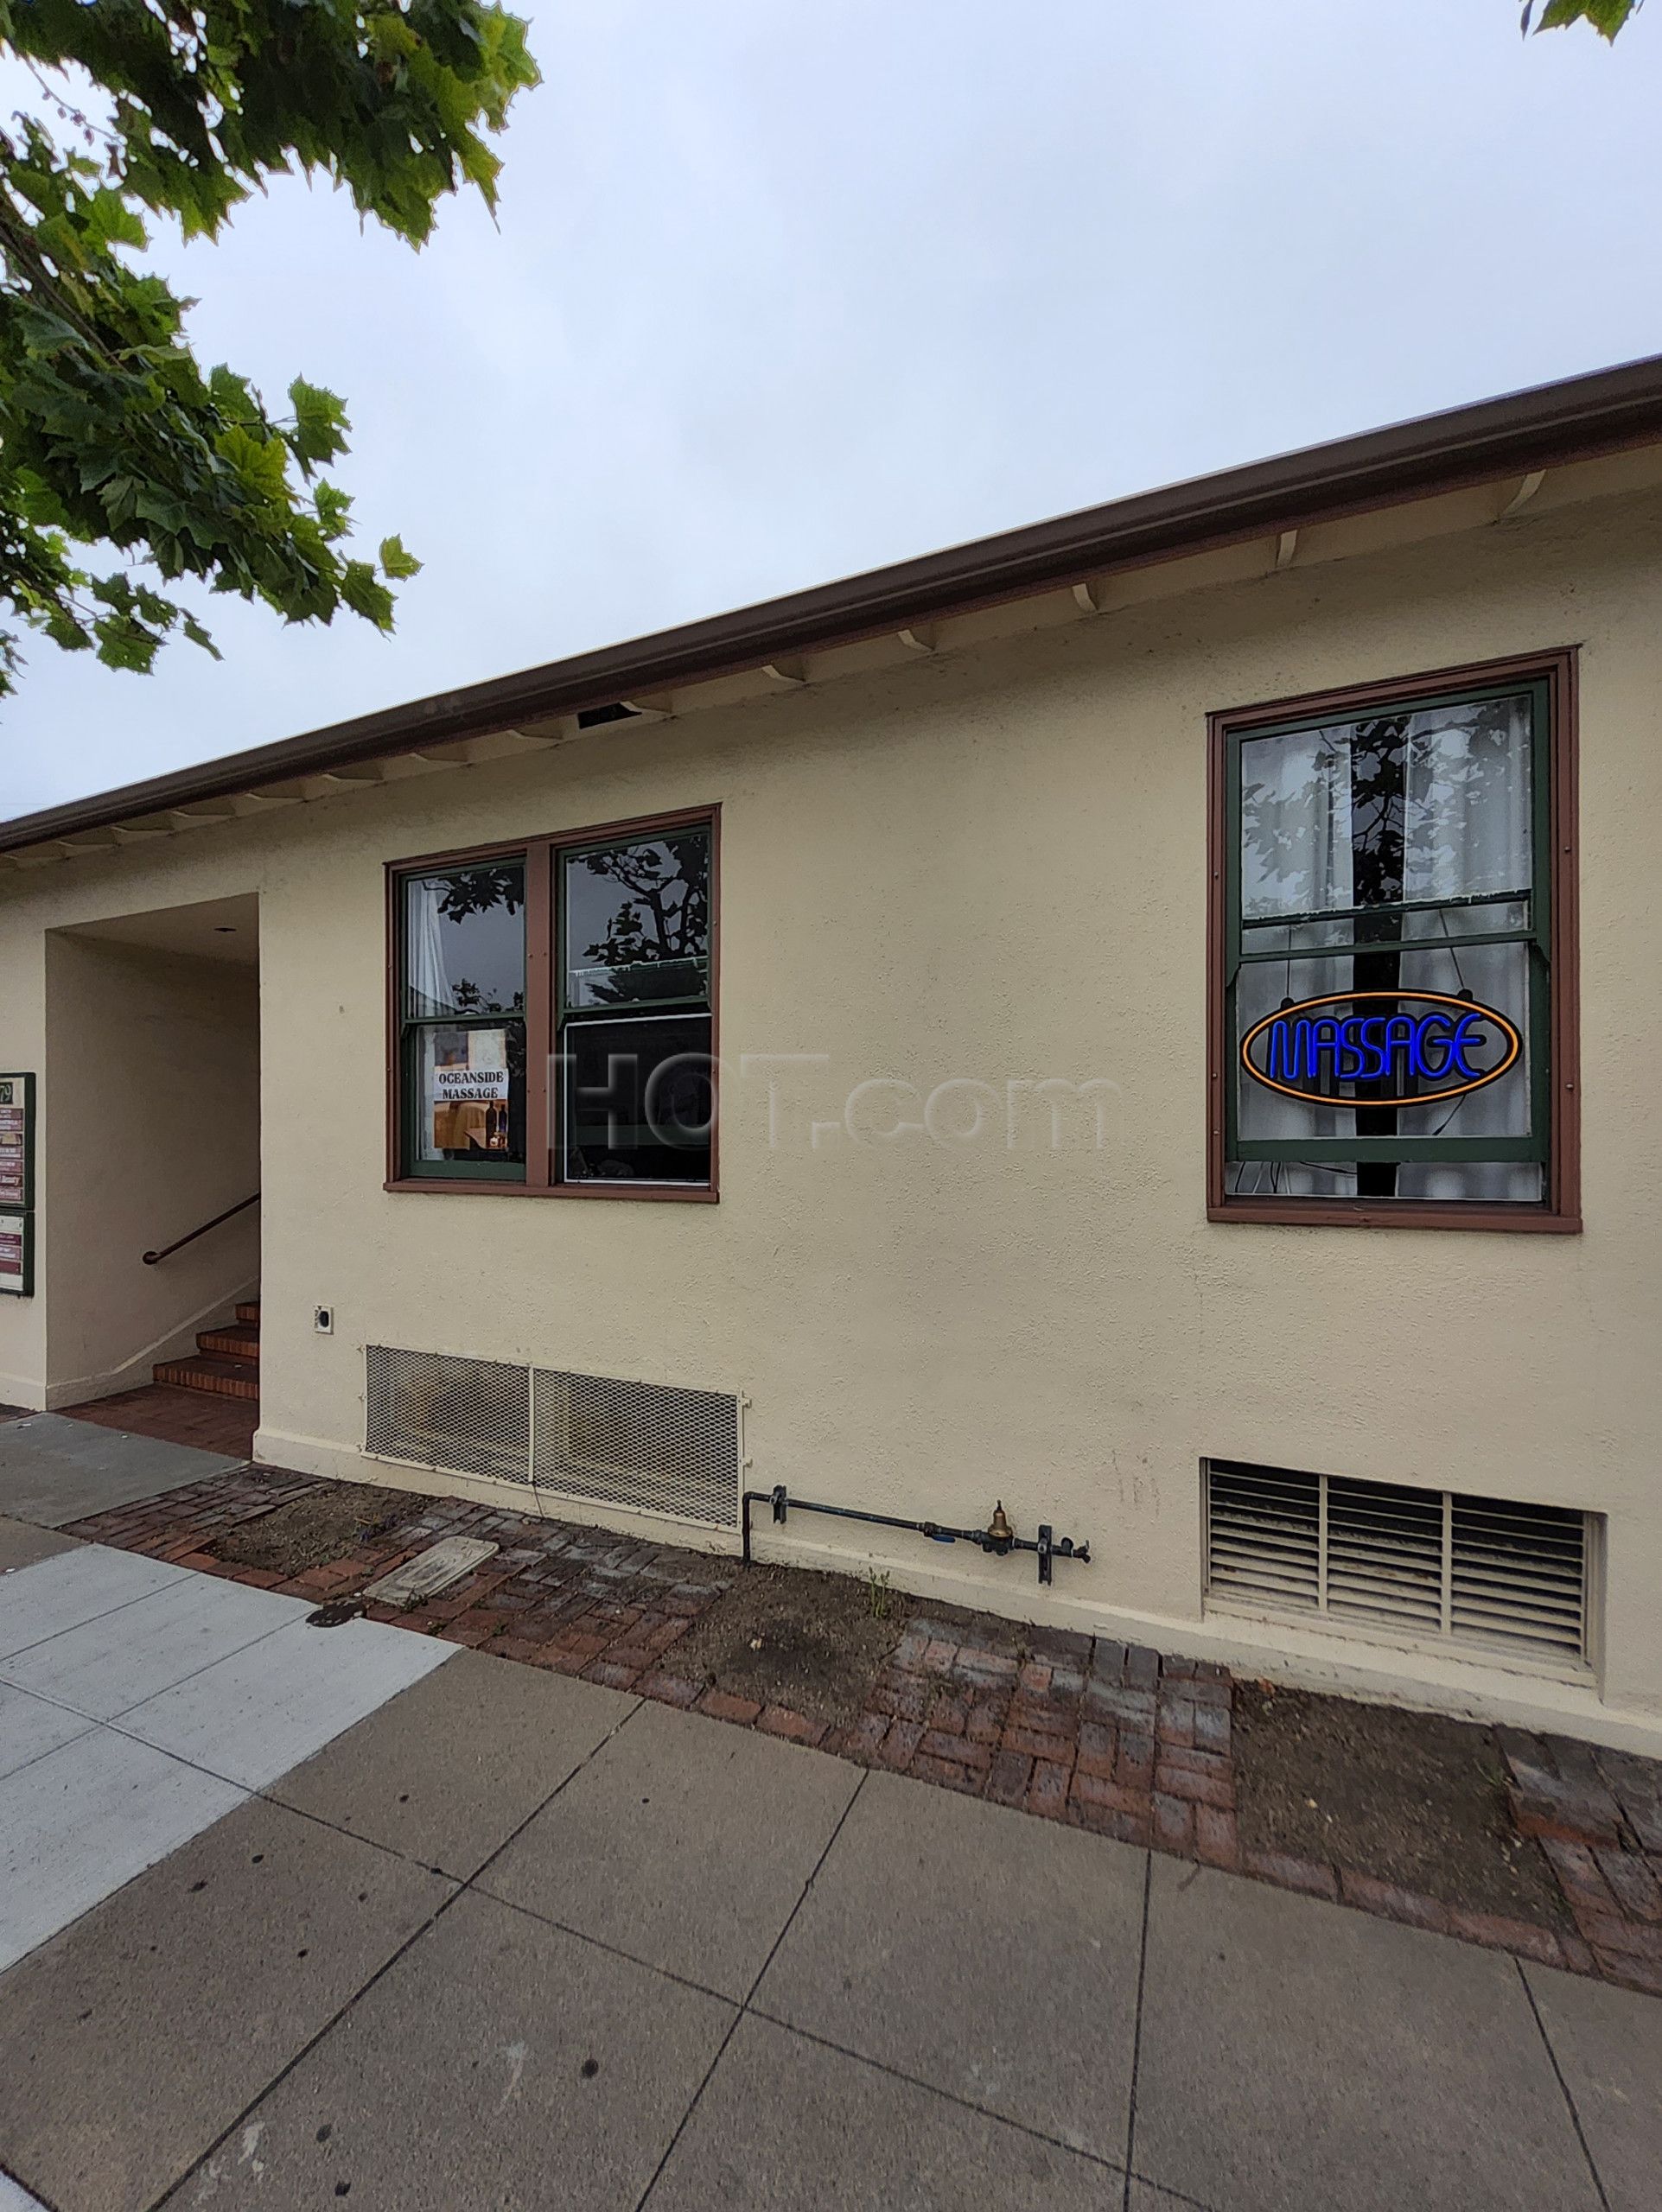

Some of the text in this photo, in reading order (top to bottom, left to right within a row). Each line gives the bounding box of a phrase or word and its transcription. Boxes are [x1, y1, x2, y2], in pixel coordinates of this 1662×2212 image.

[1270, 1014, 1481, 1078] MASSAGE
[439, 1071, 504, 1084] OCEANSIDE
[443, 1087, 498, 1100] MASSAGE
